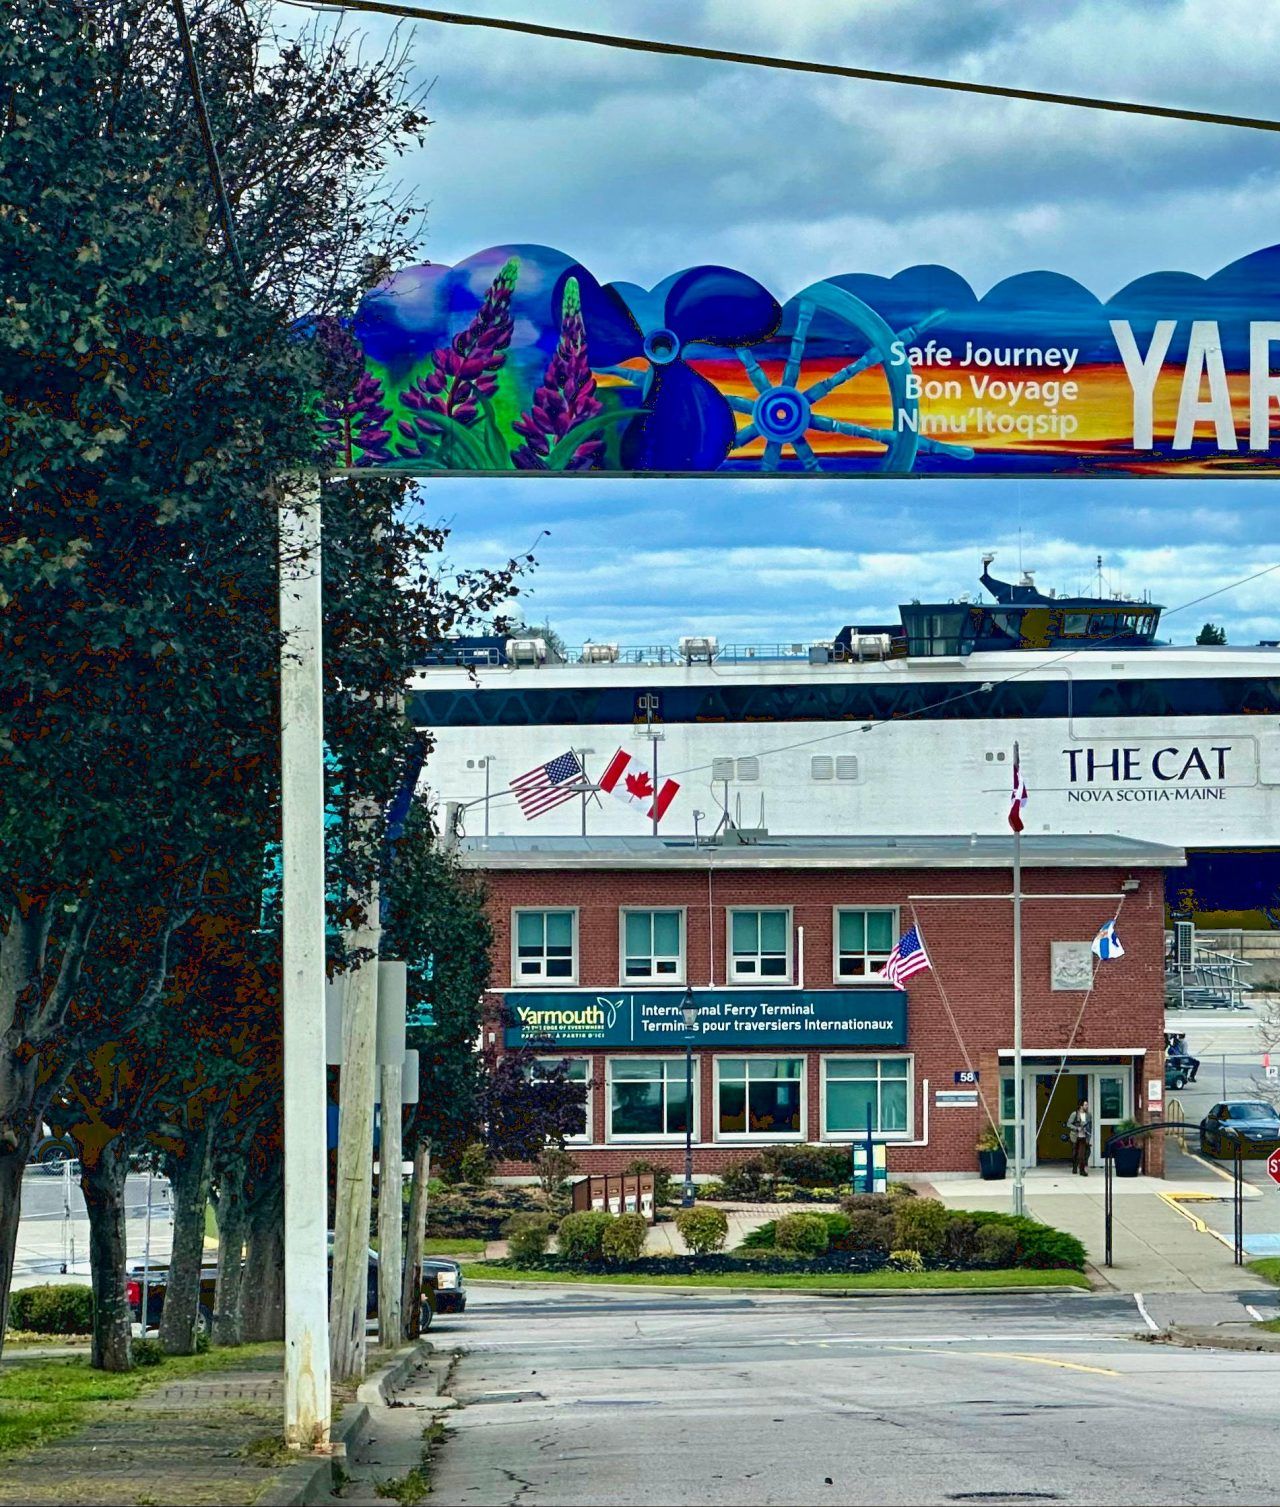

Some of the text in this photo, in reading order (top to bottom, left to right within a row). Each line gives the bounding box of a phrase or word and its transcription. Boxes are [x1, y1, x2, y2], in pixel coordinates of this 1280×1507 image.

[890, 340, 1079, 374] Safe Journey
[904, 375, 1079, 406] Bon Voyage
[1062, 747, 1232, 782] THE CAT
[1068, 788, 1227, 802] NOVA SCOTIA-MAINE
[517, 1005, 604, 1025] Yarmouth
[641, 1003, 815, 1018] Internnal Ferry Terminal
[641, 1018, 894, 1034] Termins pour traversiers Internationaux
[960, 1072, 974, 1082] 58
